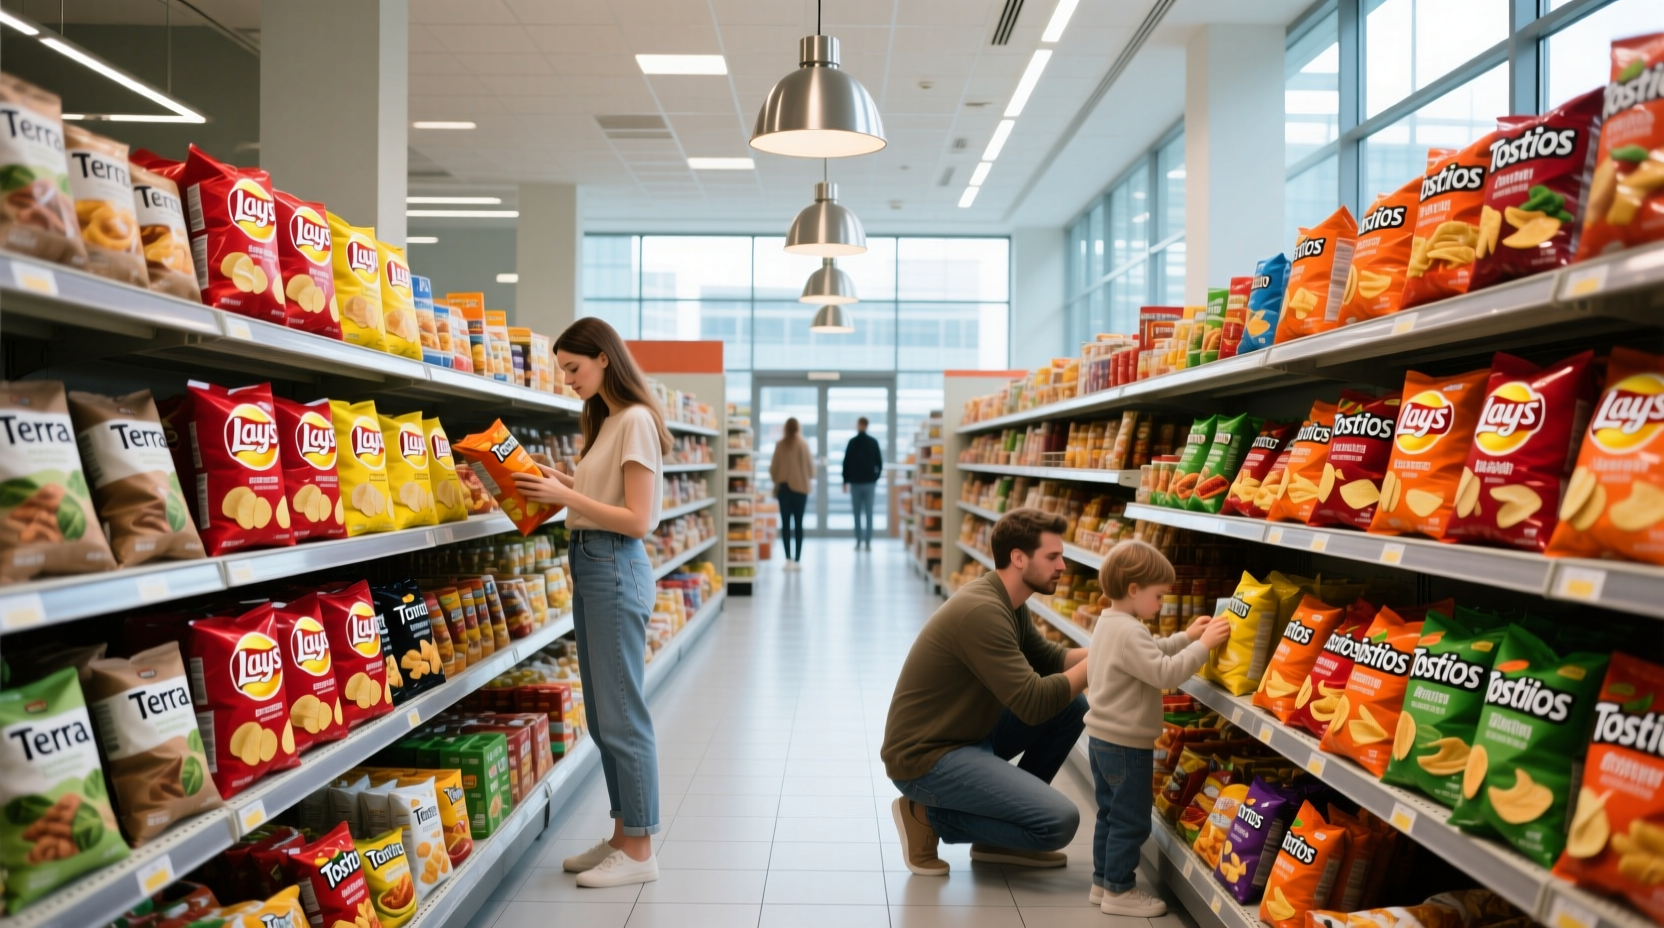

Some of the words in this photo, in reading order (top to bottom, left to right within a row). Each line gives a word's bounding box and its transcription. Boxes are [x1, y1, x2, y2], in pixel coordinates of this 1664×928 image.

[1489, 126, 1576, 173] Tostios
[234, 188, 276, 228] Lays
[0, 415, 73, 446] Terra
[1396, 403, 1449, 438] Lays
[1476, 396, 1540, 437] Lays
[110, 423, 169, 450] Terra
[231, 417, 278, 455] Lays
[302, 423, 336, 456] Lays
[296, 629, 329, 663] Lays
[237, 647, 282, 687] Lays
[1409, 648, 1484, 689] Tostios
[128, 686, 191, 720] Terra
[9, 721, 91, 762] Terra
